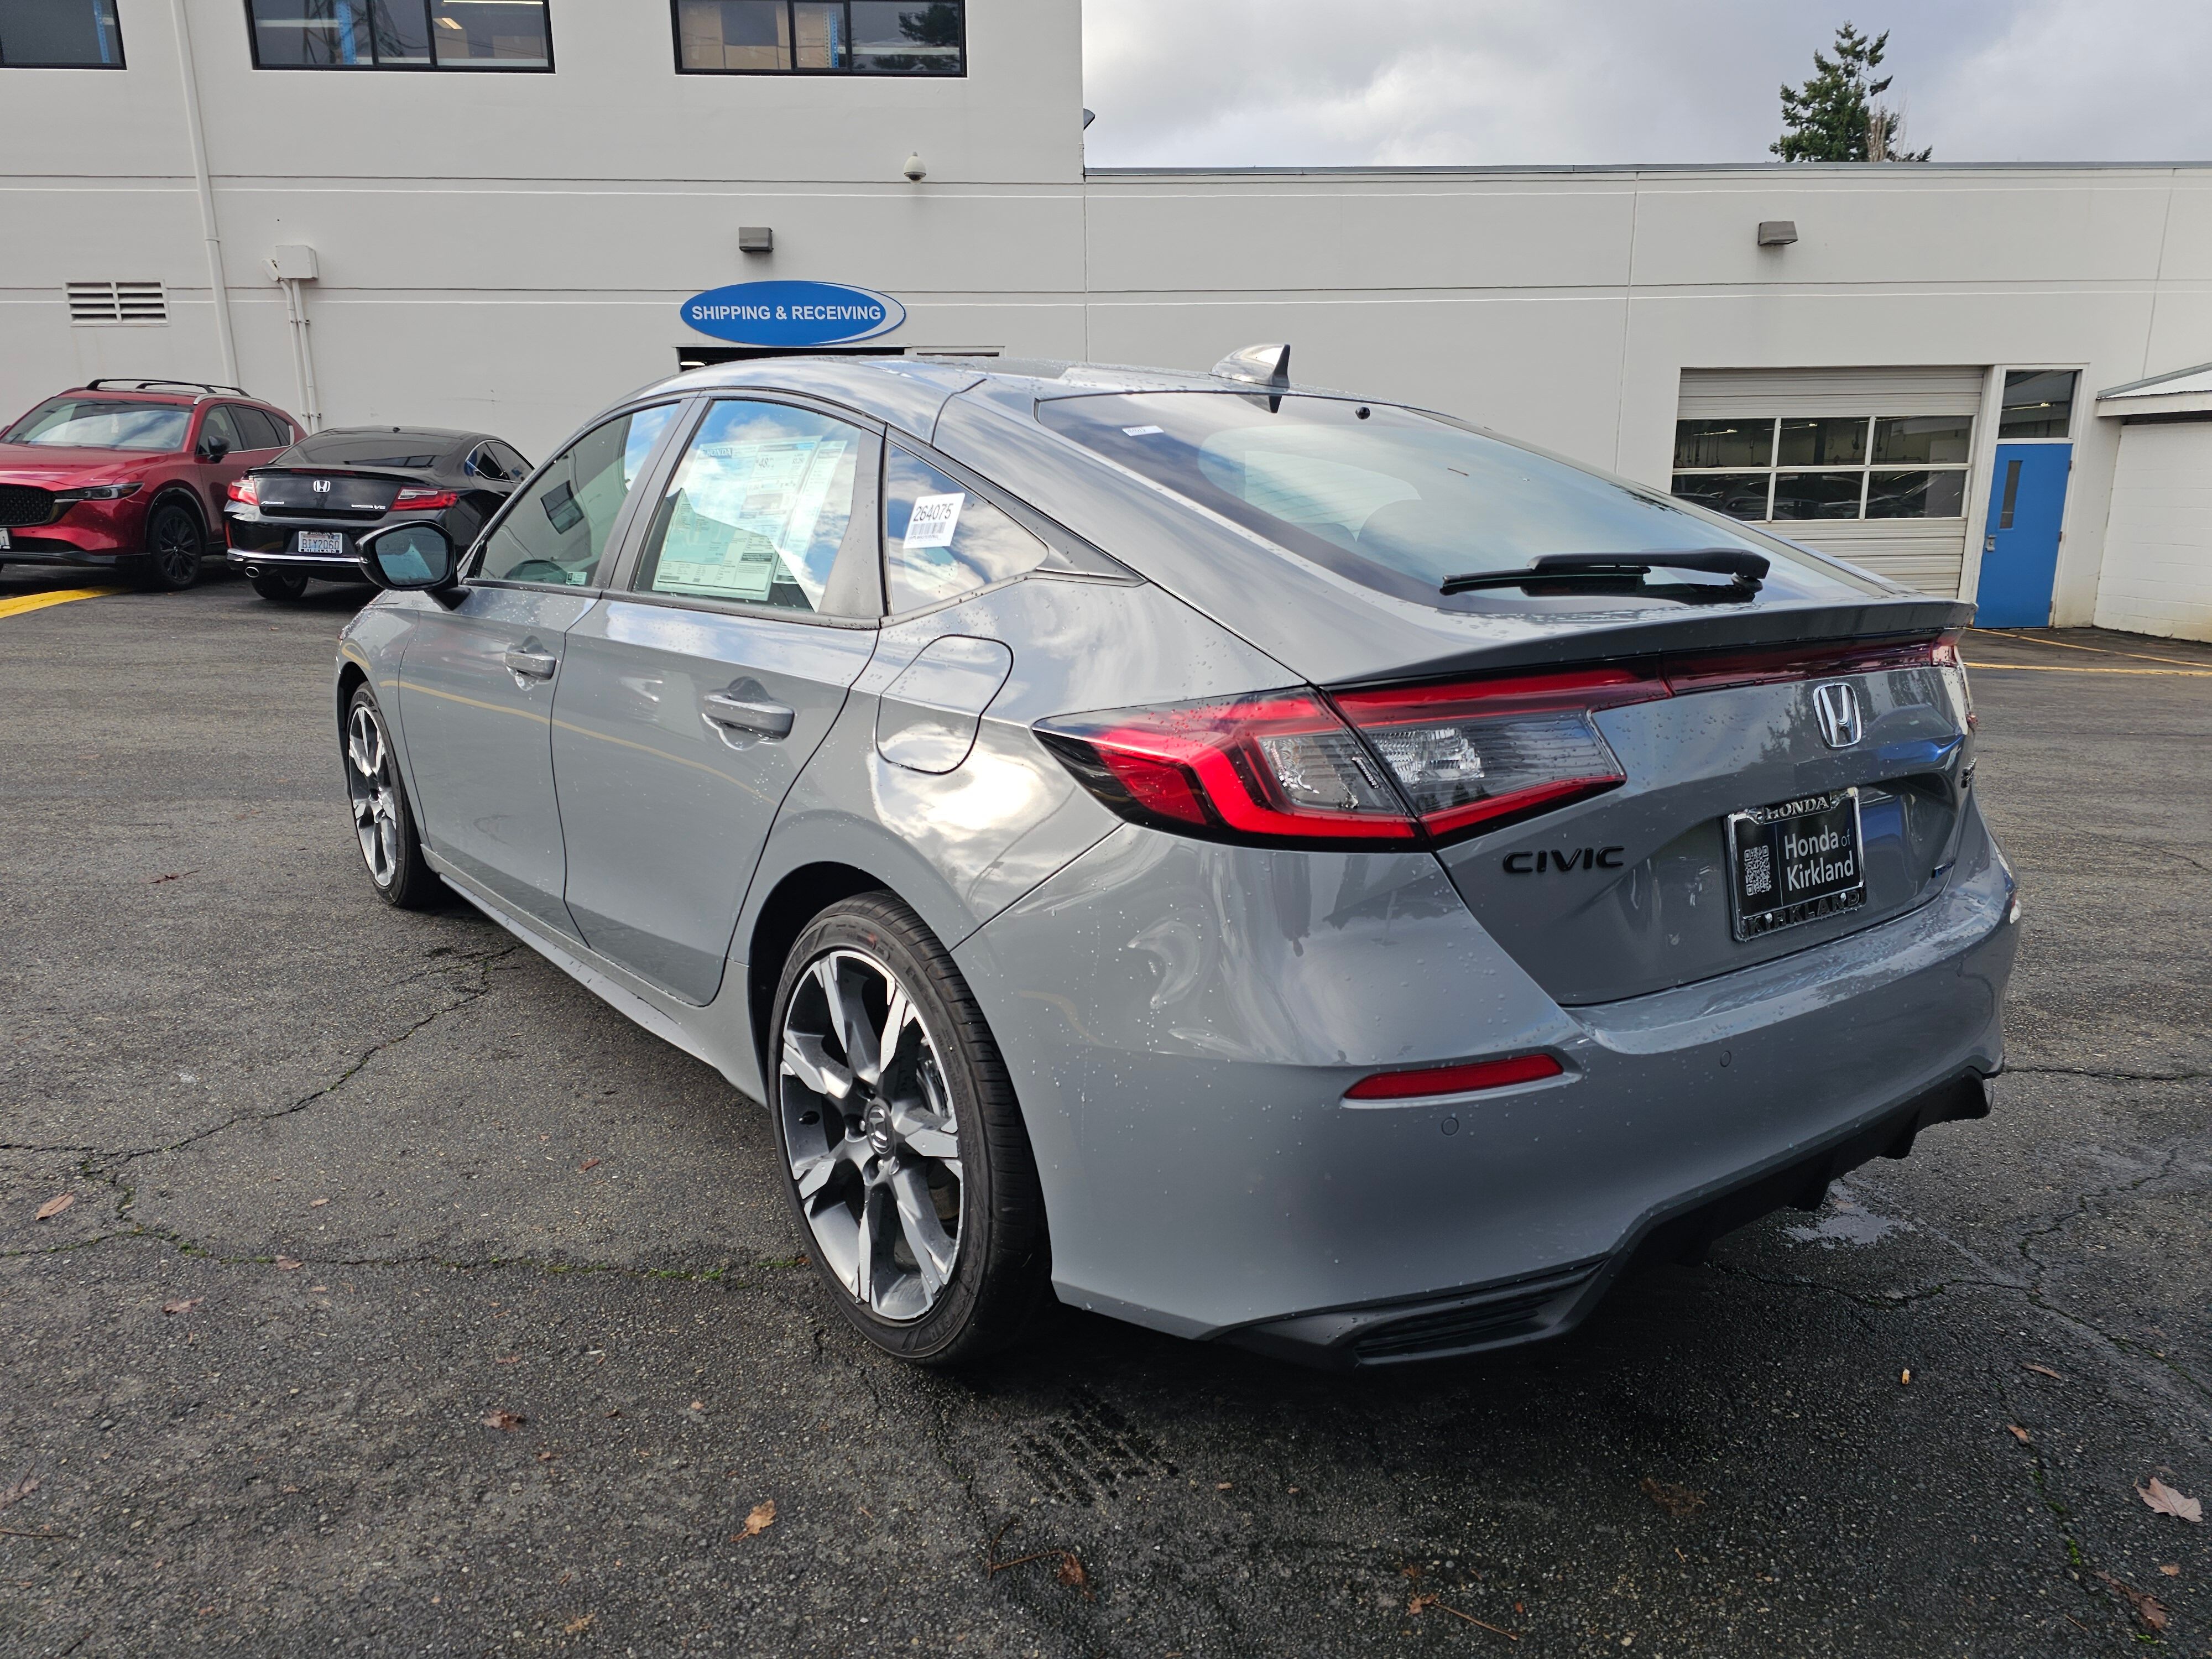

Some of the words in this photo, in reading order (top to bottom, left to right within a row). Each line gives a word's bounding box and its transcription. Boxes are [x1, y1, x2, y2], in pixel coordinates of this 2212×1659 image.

[692, 305, 770, 320] SHIPPING
[775, 306, 787, 320] &
[792, 306, 881, 320] RECEIVING
[913, 503, 954, 522] 264075
[302, 539, 340, 550] BIY2060
[1764, 796, 1829, 821] HONDA
[1784, 825, 1839, 860] Honda
[1841, 828, 1851, 847] of
[1503, 846, 1625, 874] CIVIC
[1787, 850, 1854, 892] Kirkland
[1747, 890, 1860, 935] KIRKLAND
